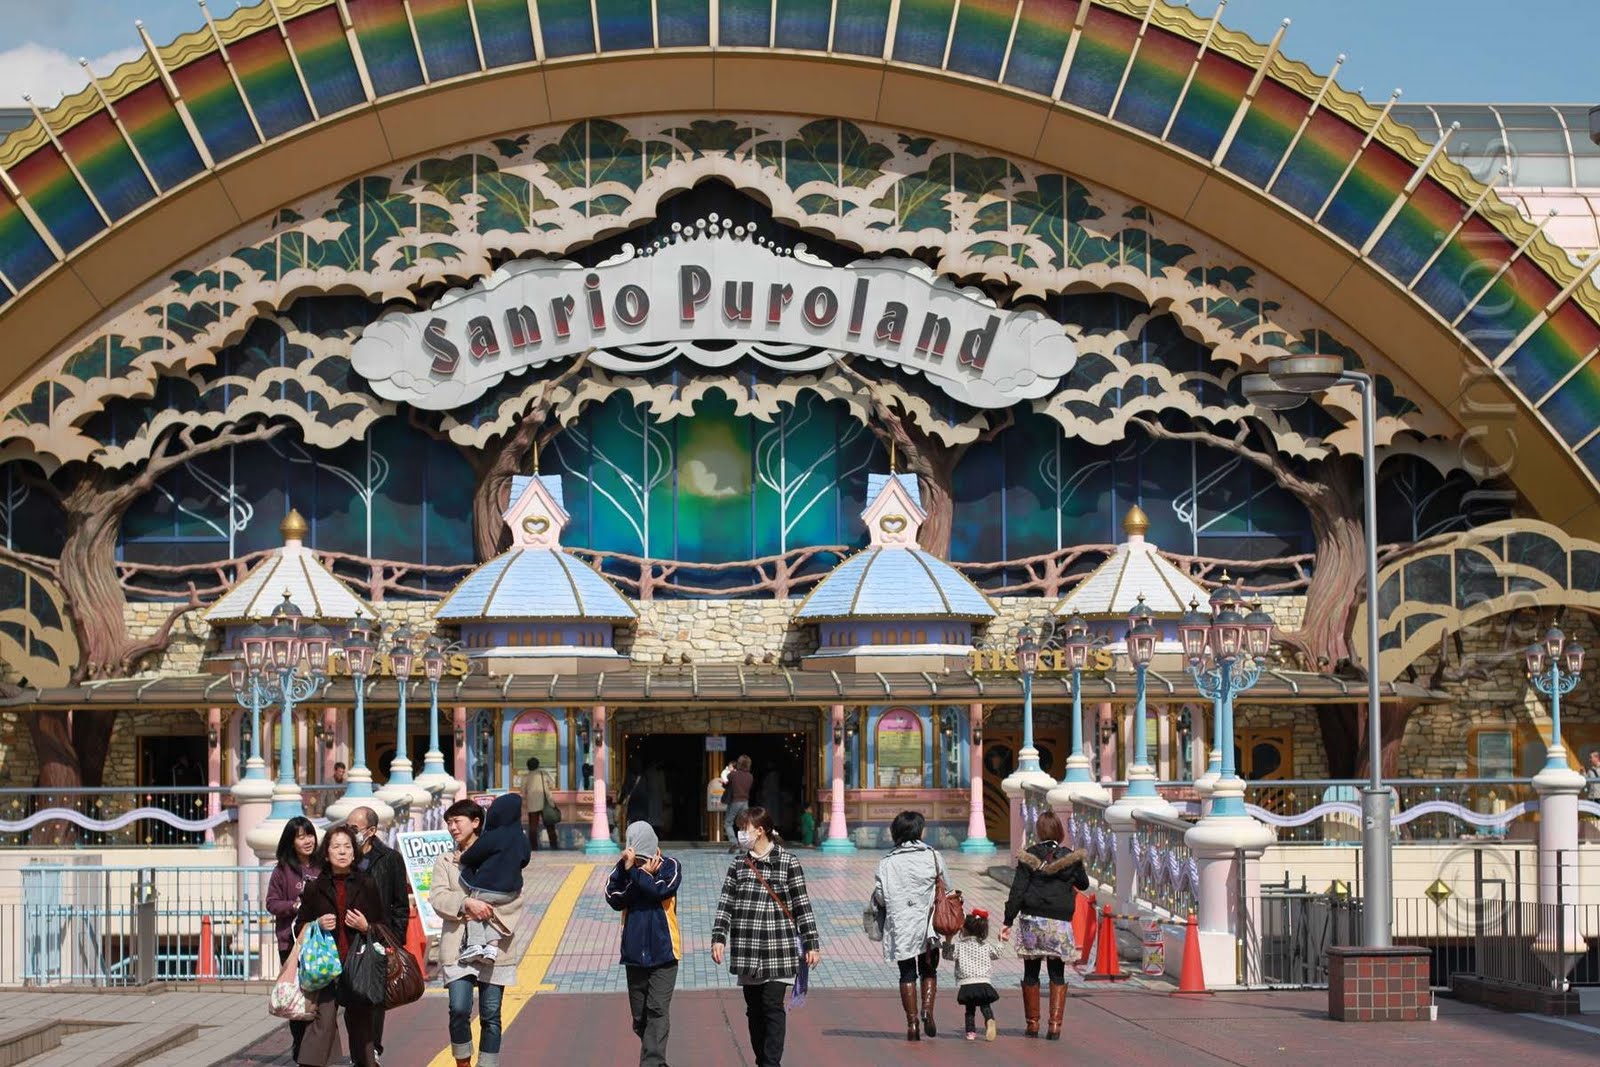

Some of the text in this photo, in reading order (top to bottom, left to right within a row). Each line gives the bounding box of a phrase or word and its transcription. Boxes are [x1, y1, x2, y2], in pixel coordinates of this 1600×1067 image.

[423, 264, 1002, 374] Sanrio Puroland
[403, 837, 456, 858] iPhone
